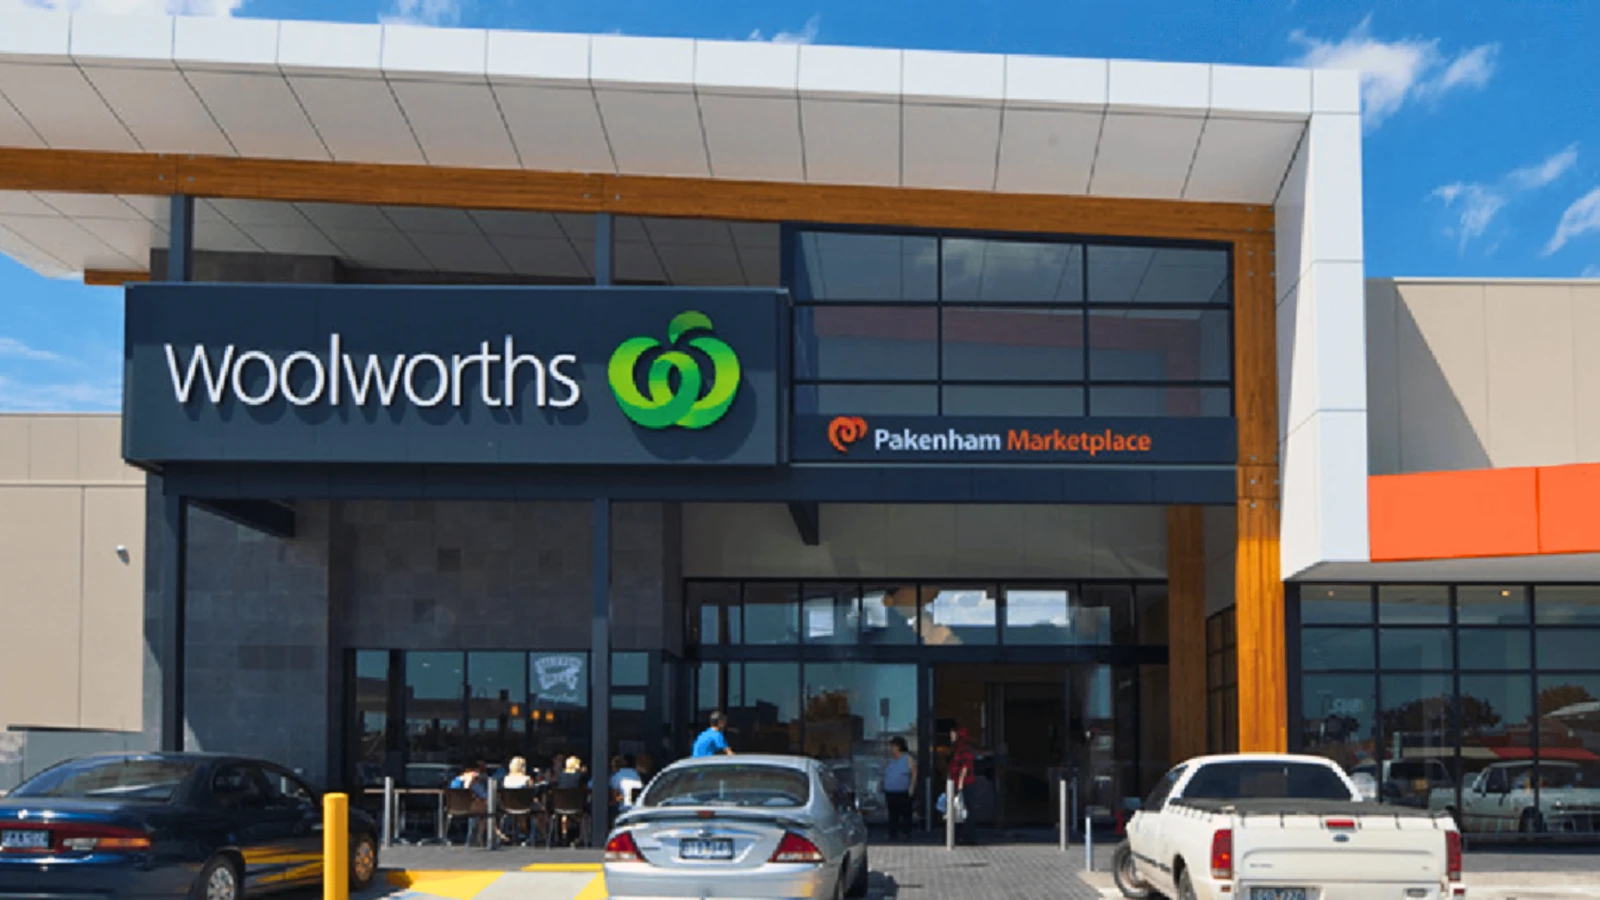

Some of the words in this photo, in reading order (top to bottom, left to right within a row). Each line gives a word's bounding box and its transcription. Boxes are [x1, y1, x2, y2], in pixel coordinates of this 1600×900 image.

[164, 333, 580, 408] Woolworths
[874, 428, 1001, 451] Pakenham
[1007, 429, 1152, 456] Marketplace
